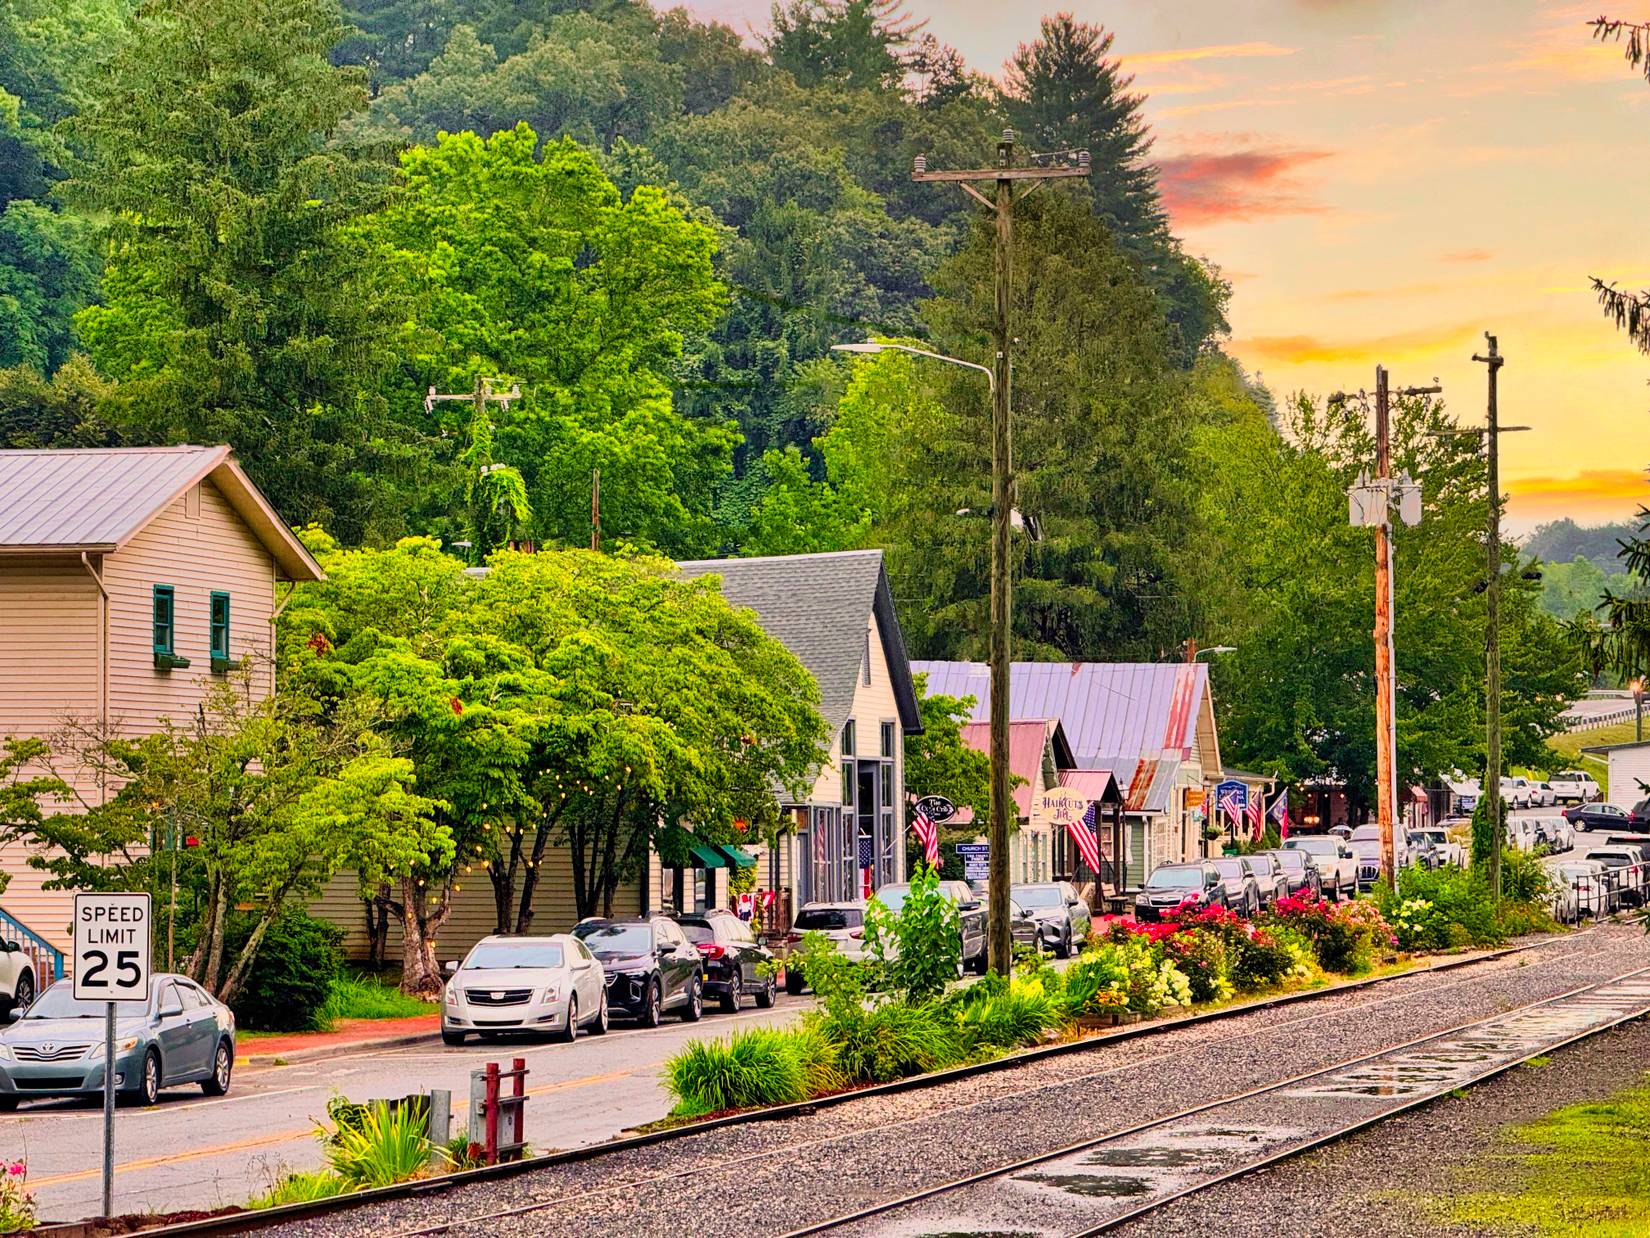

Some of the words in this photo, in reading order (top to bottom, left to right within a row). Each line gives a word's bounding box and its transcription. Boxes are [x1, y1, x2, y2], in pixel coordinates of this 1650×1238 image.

[81, 906, 144, 922] SPEED
[87, 928, 137, 944] LIMIT
[81, 949, 142, 988] 25
